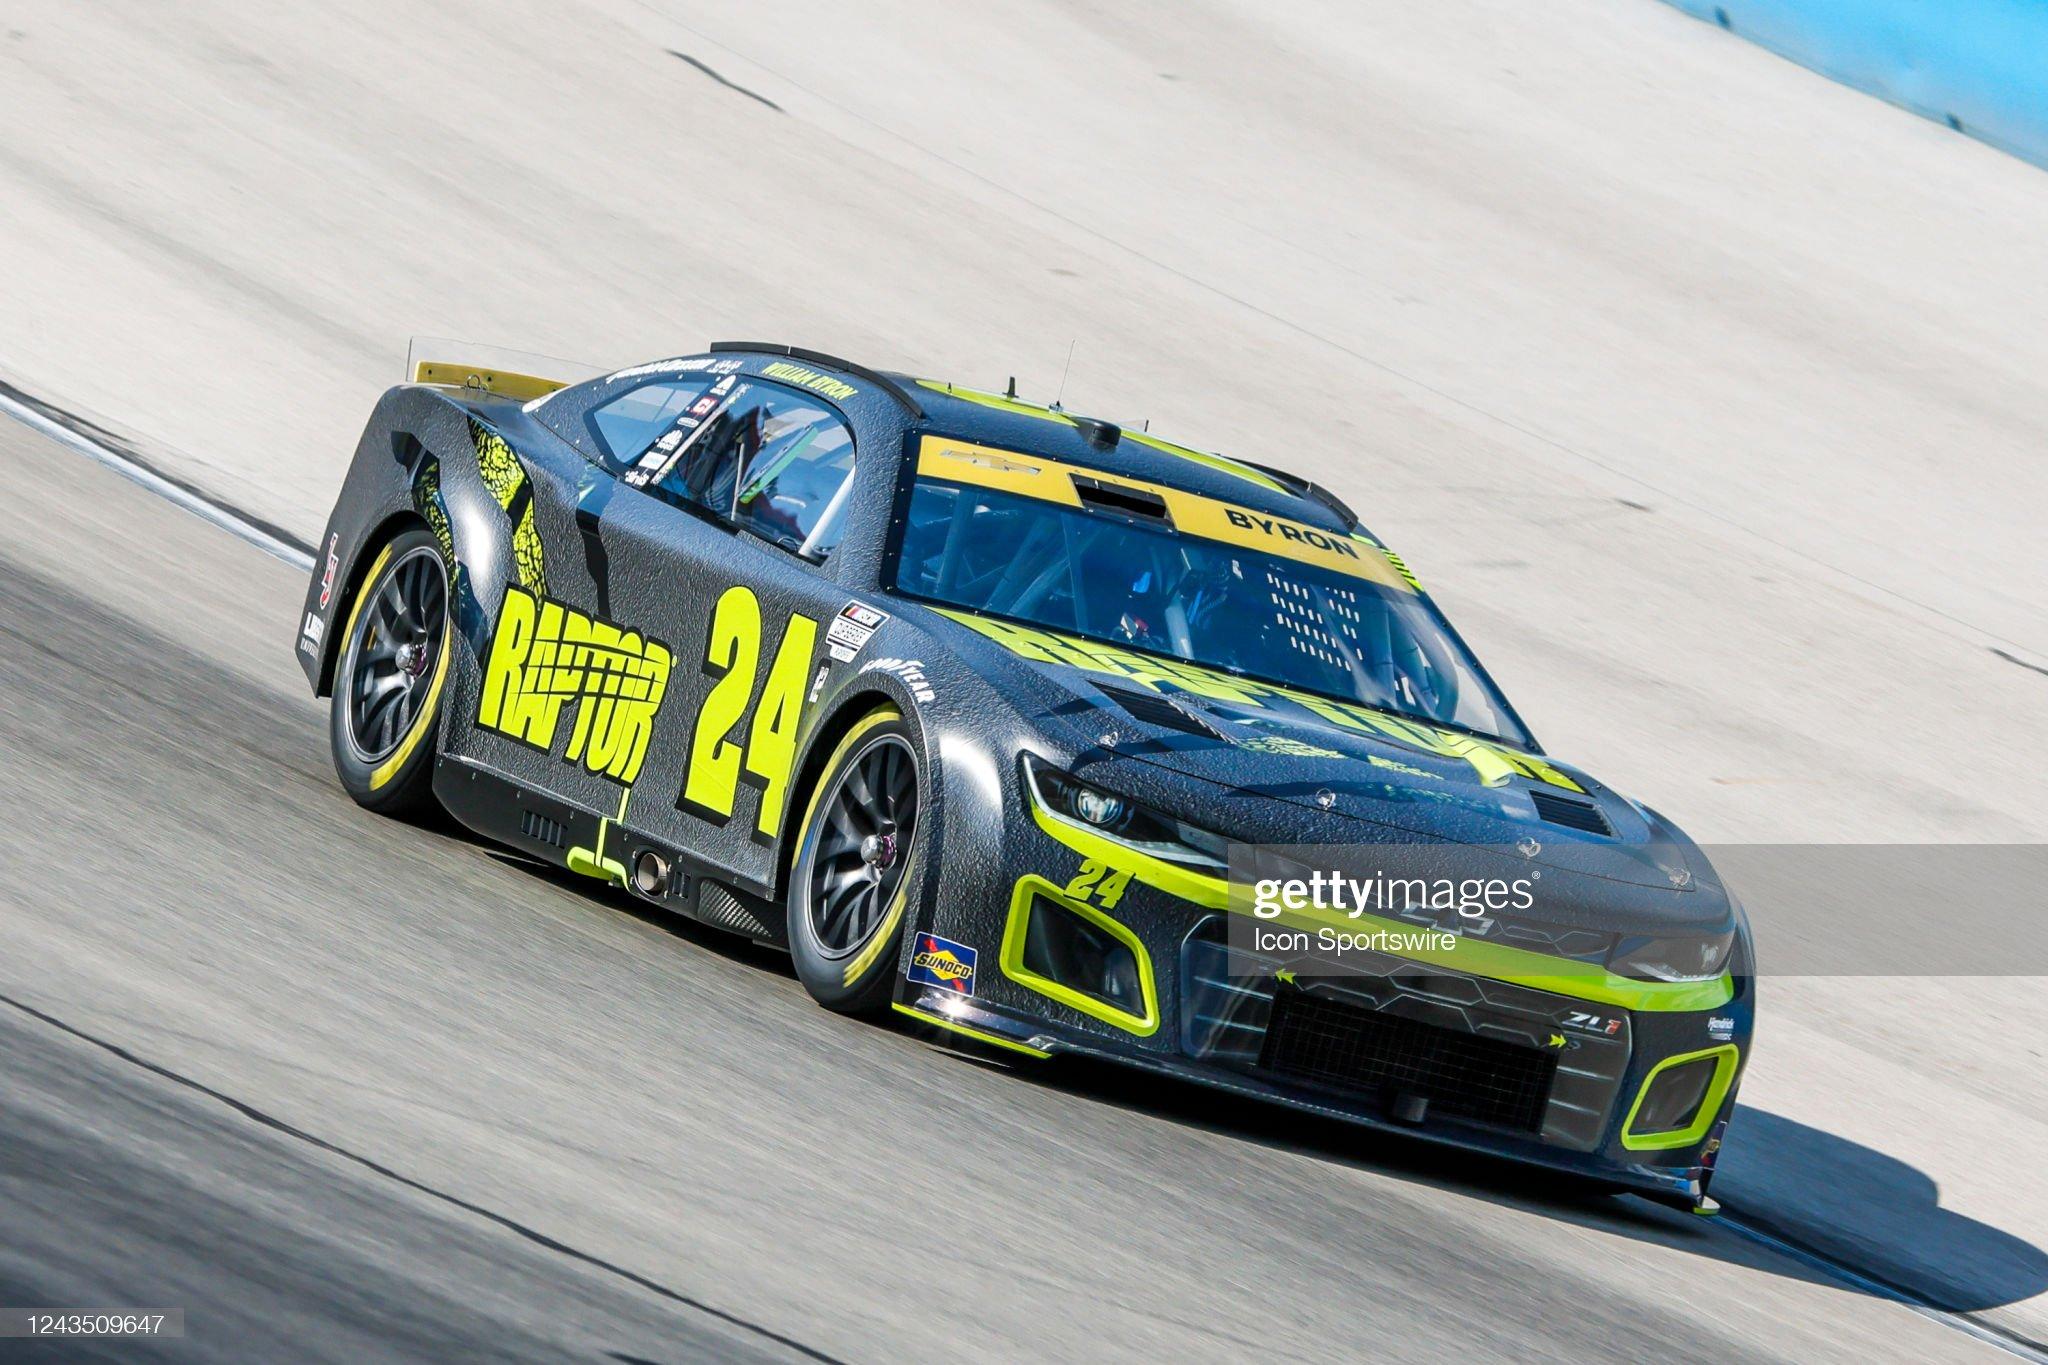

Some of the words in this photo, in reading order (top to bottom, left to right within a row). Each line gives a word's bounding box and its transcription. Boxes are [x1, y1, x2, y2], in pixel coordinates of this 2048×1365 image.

[1224, 508, 1360, 560] BYRON
[478, 587, 671, 784] RAPTOR
[684, 585, 819, 839] 24
[1064, 858, 1135, 909] 24
[915, 952, 973, 979] SUNOCO
[1562, 1011, 1622, 1035] ZL1
